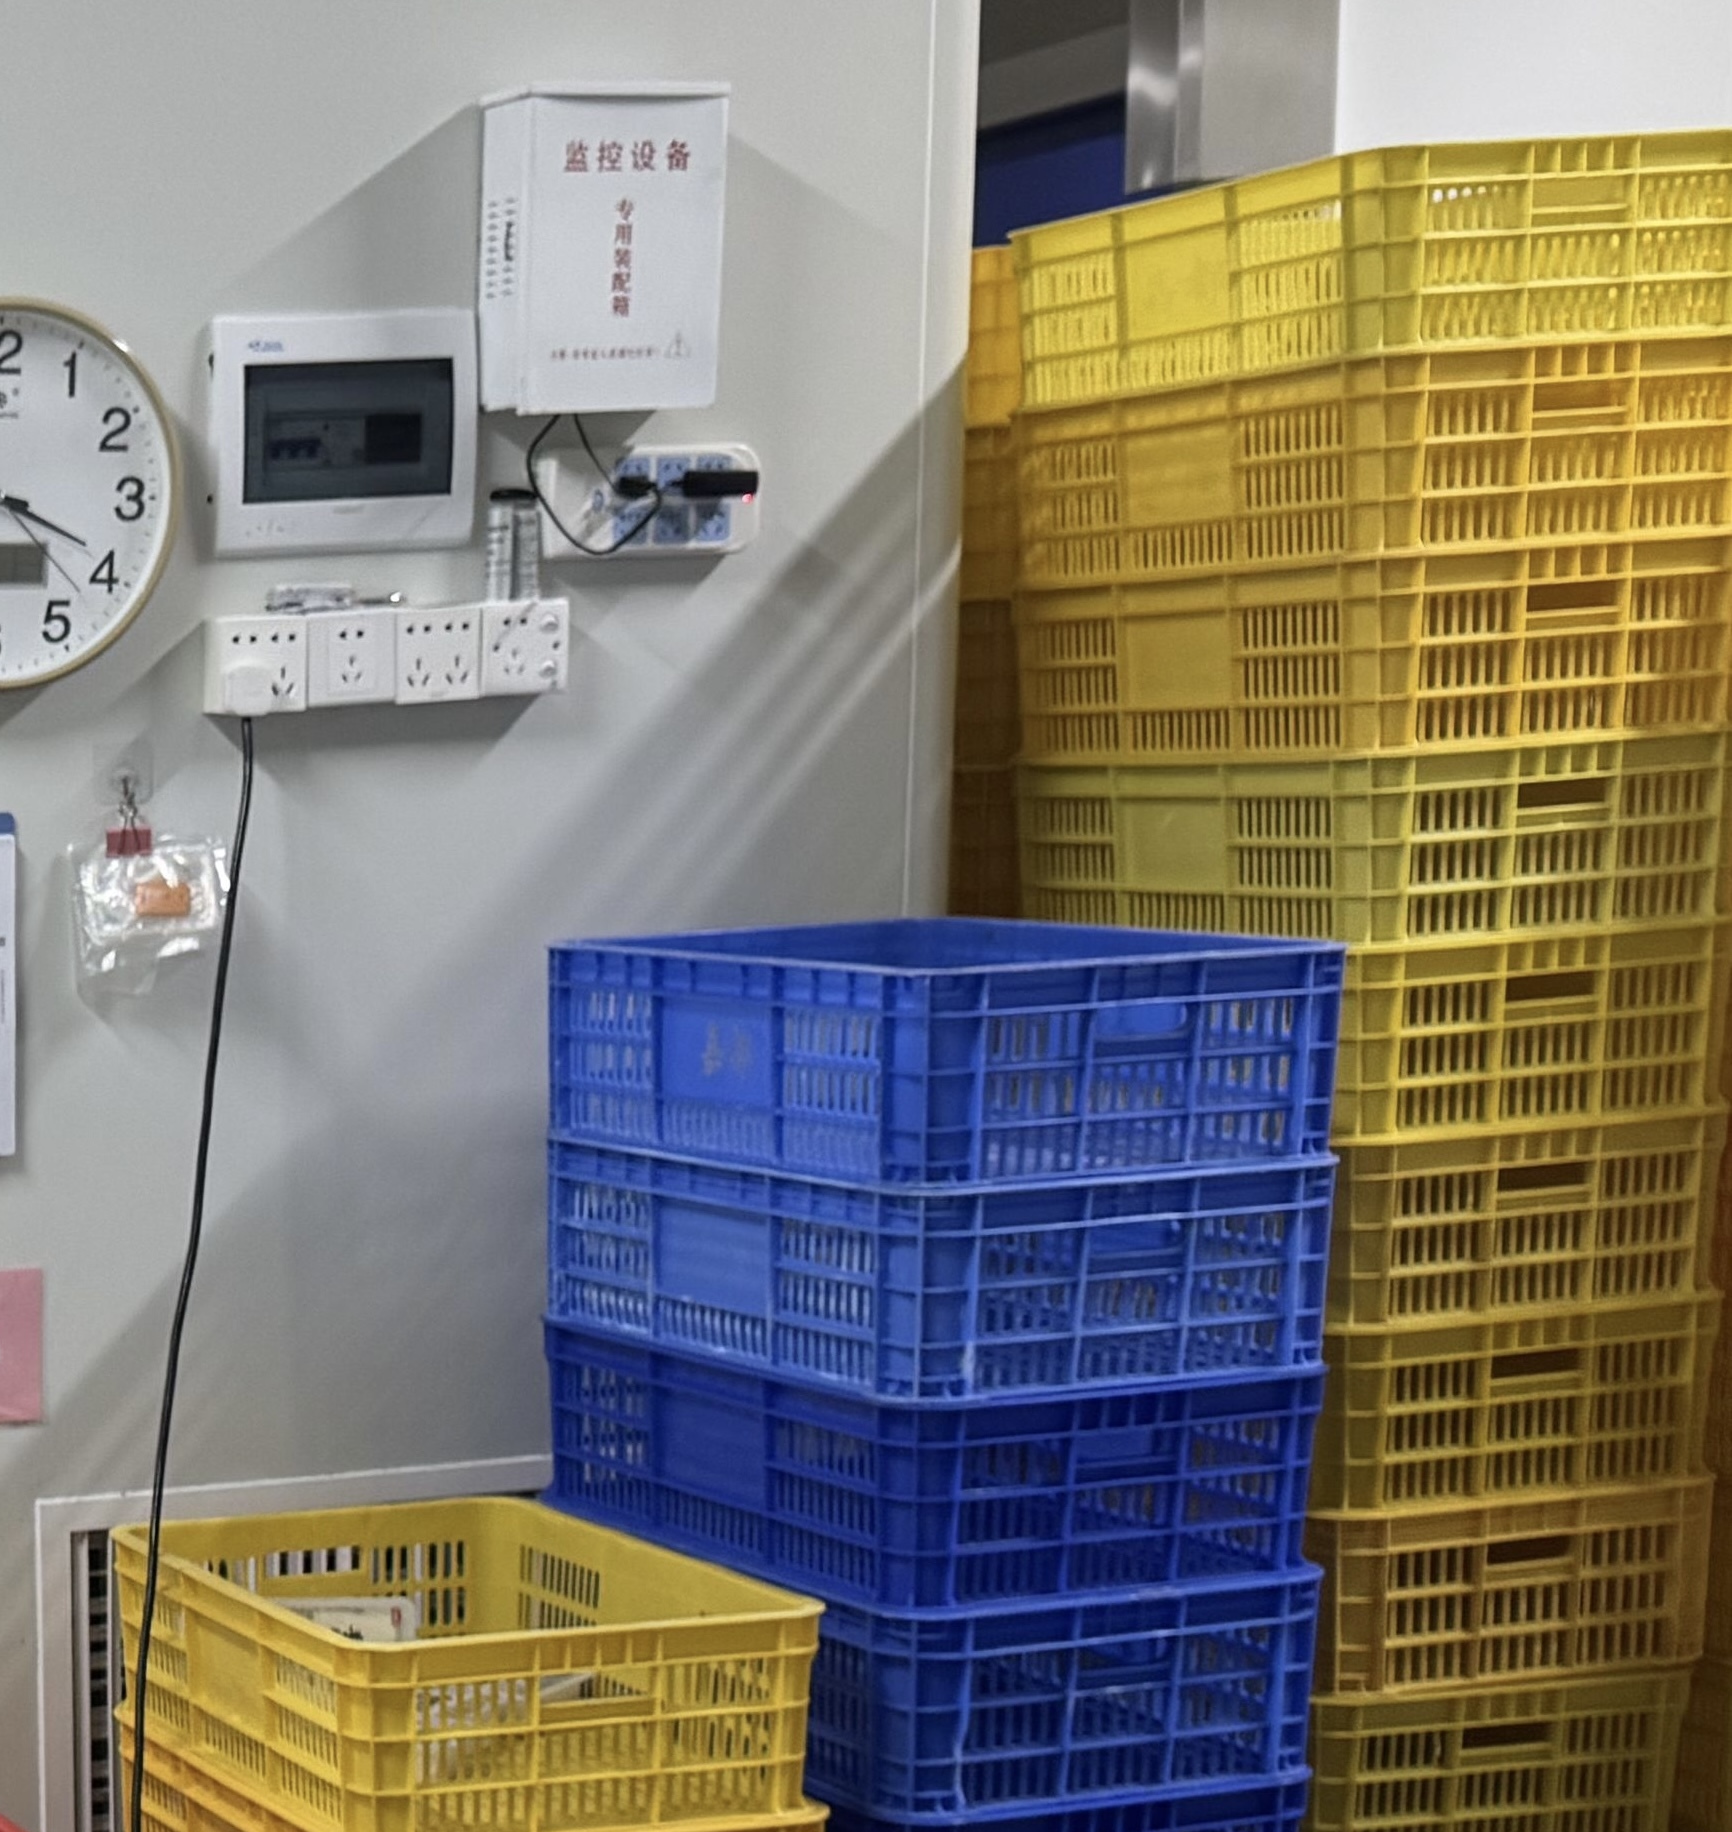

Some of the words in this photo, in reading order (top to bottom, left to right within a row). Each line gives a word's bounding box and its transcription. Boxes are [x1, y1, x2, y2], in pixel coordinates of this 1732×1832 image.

[563, 138, 692, 174] 监控设备
[63, 352, 77, 397] 1
[99, 407, 131, 452] 2
[115, 476, 145, 522] 3
[90, 550, 120, 593] 4
[42, 600, 71, 643] 5
